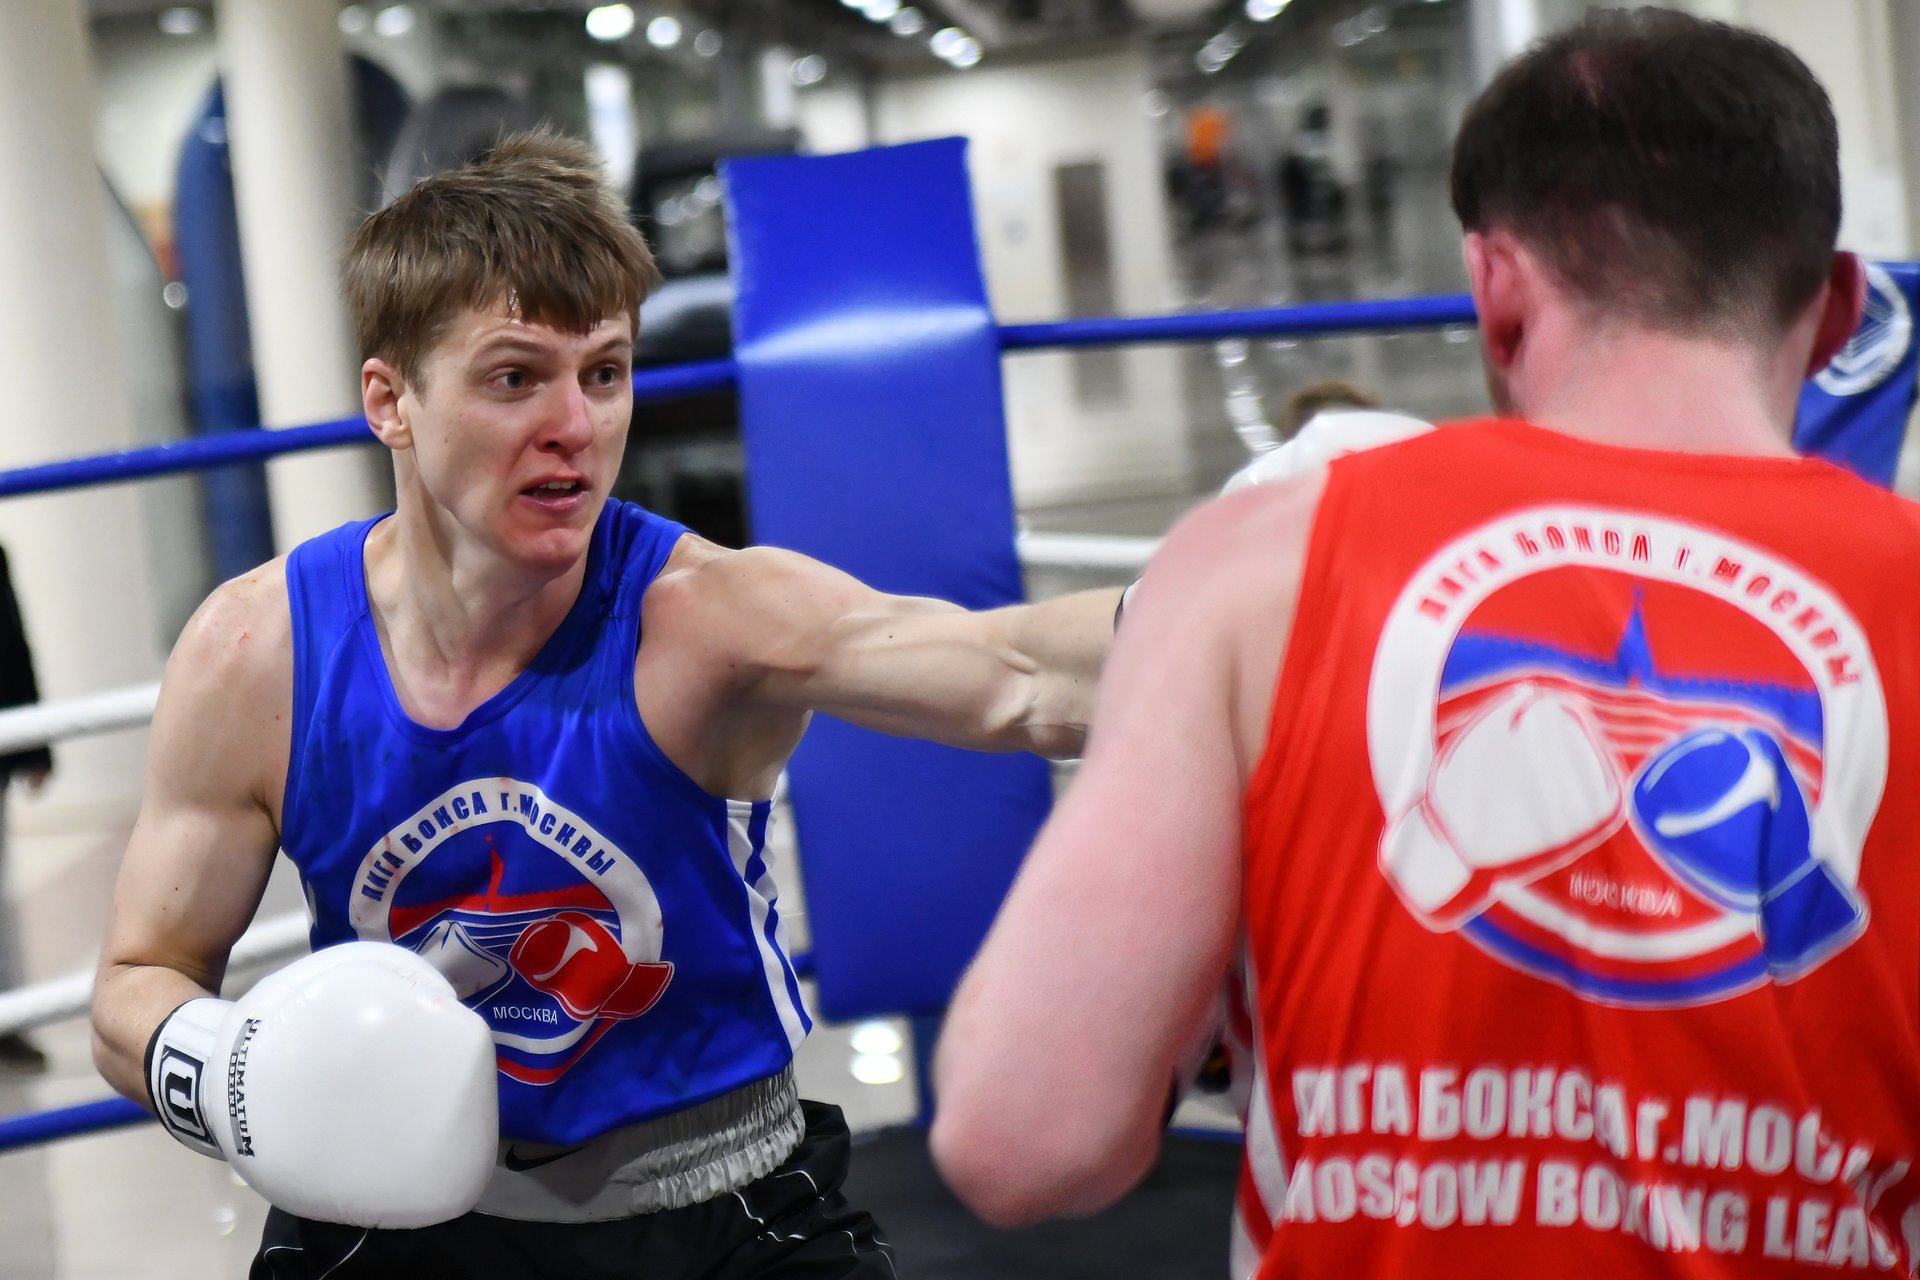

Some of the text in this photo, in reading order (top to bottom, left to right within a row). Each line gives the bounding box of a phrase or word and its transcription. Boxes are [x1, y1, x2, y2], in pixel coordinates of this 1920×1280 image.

[361, 849, 405, 902] ЛИГА
[400, 791, 488, 854] БОКСА
[493, 1005, 558, 1025] МОСКВА
[164, 1069, 202, 1130] U
[236, 1018, 262, 1158] ULTIMATUM
[1418, 1064, 1629, 1159] БОКСА
